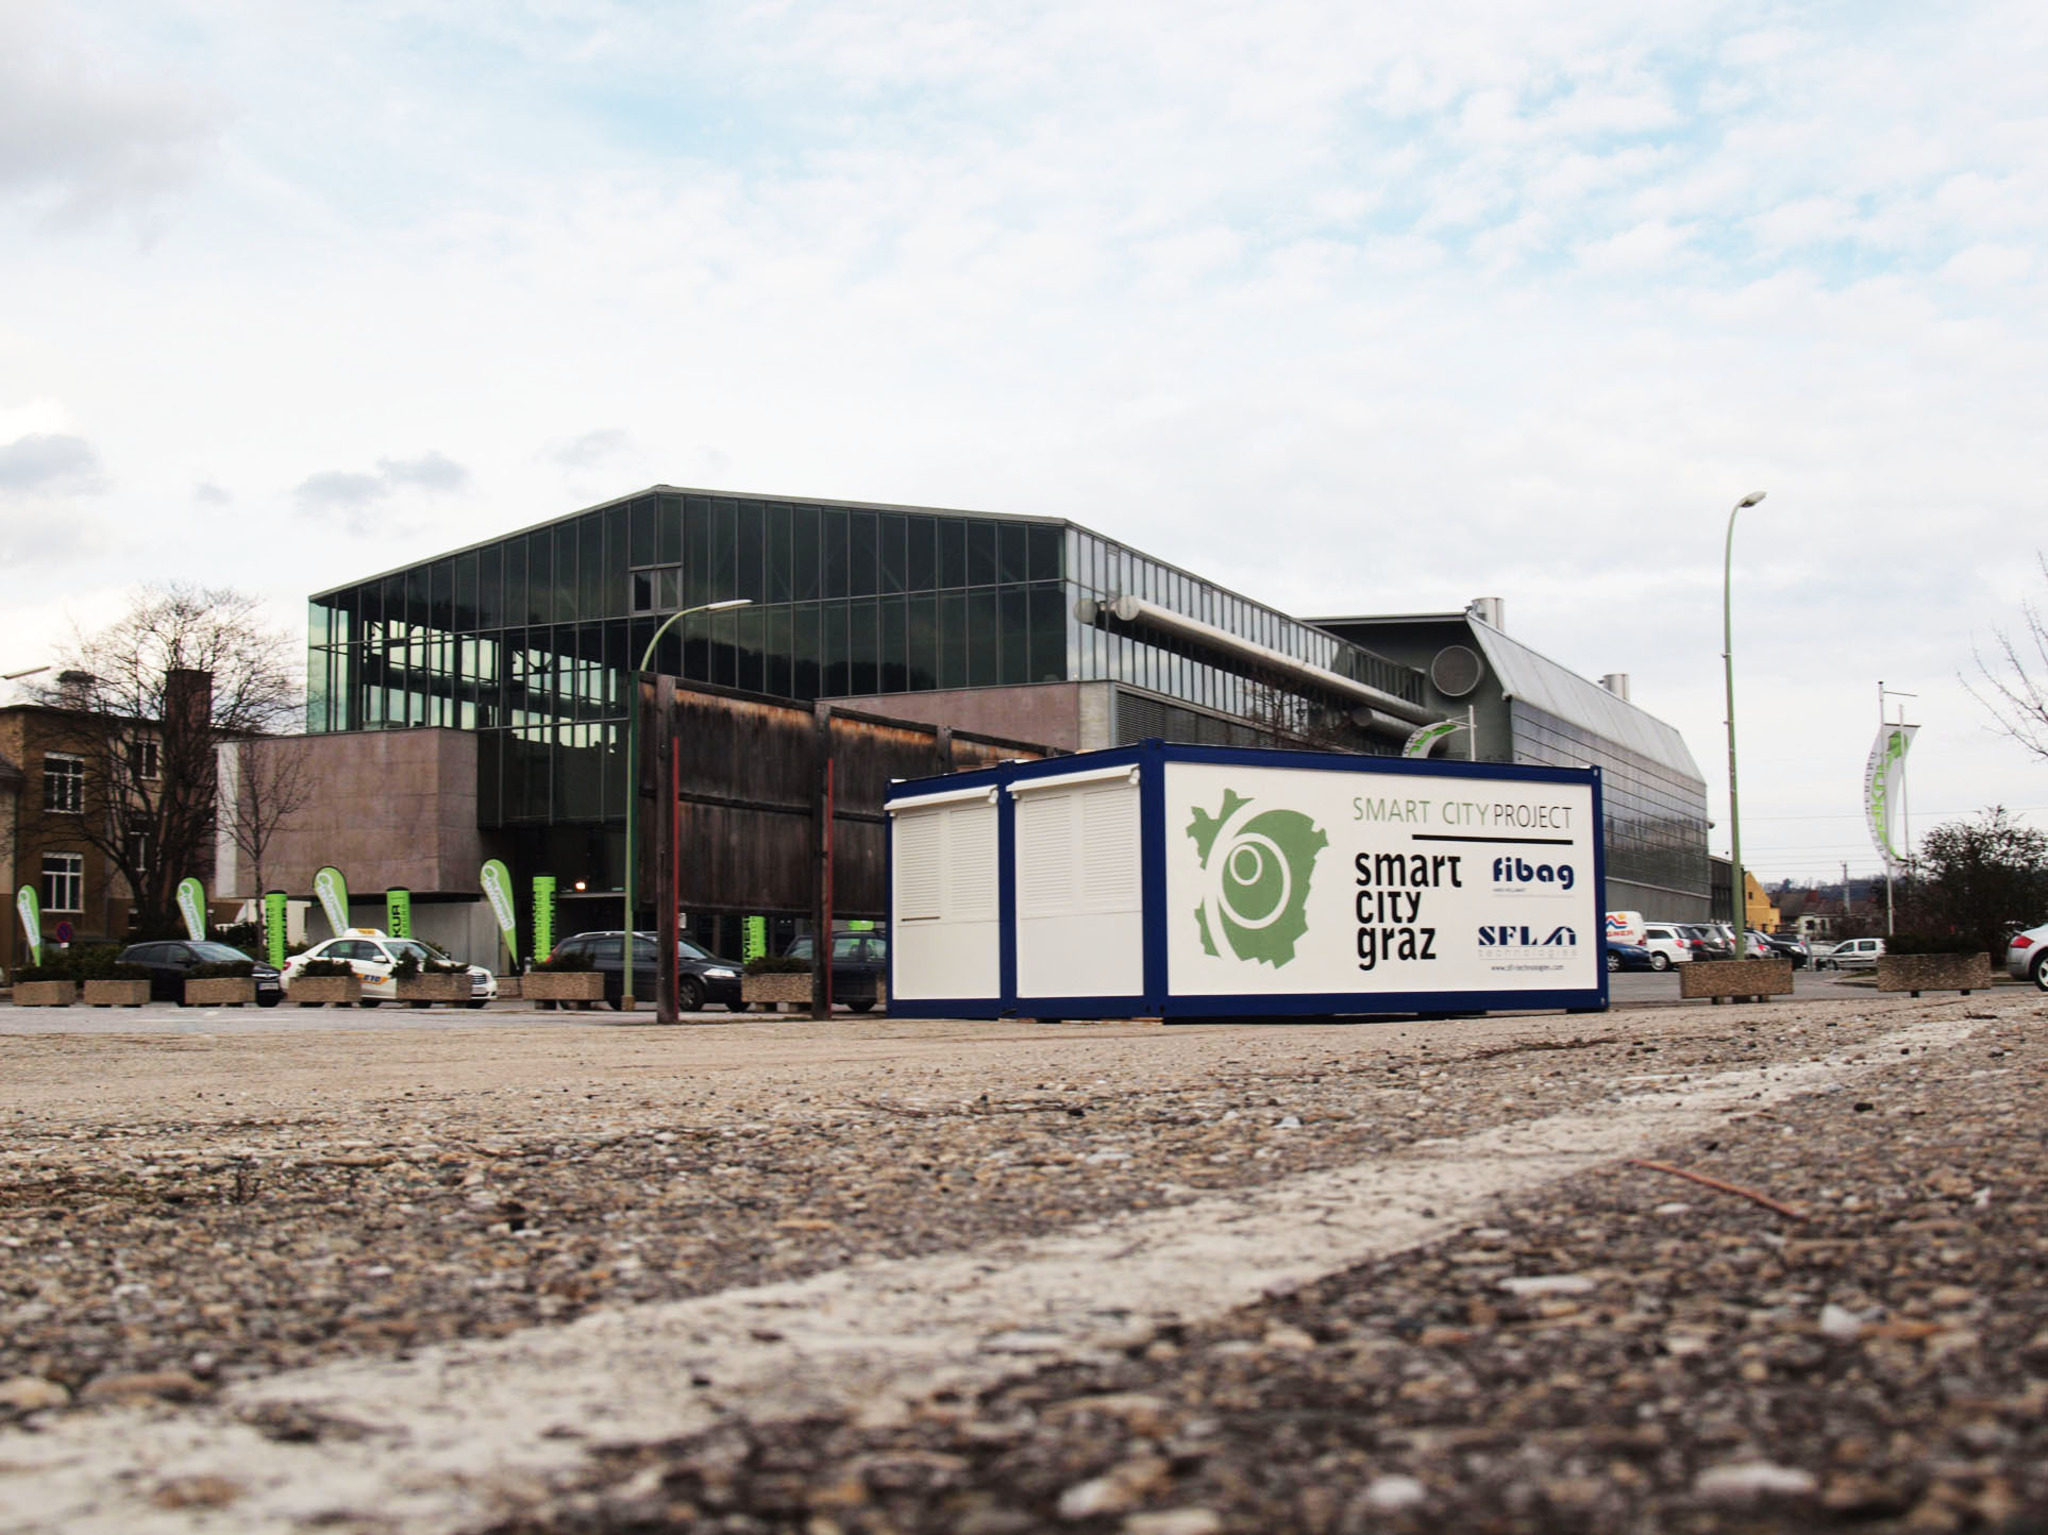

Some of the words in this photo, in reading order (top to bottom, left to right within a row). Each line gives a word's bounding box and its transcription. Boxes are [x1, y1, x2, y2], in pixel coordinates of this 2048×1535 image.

[1352, 796, 1431, 824] SMART
[1442, 801, 1490, 826] CITY
[1493, 803, 1573, 829] PROJECT
[1354, 852, 1463, 888] smart
[1492, 856, 1575, 891] fibag
[1356, 926, 1437, 972] graz
